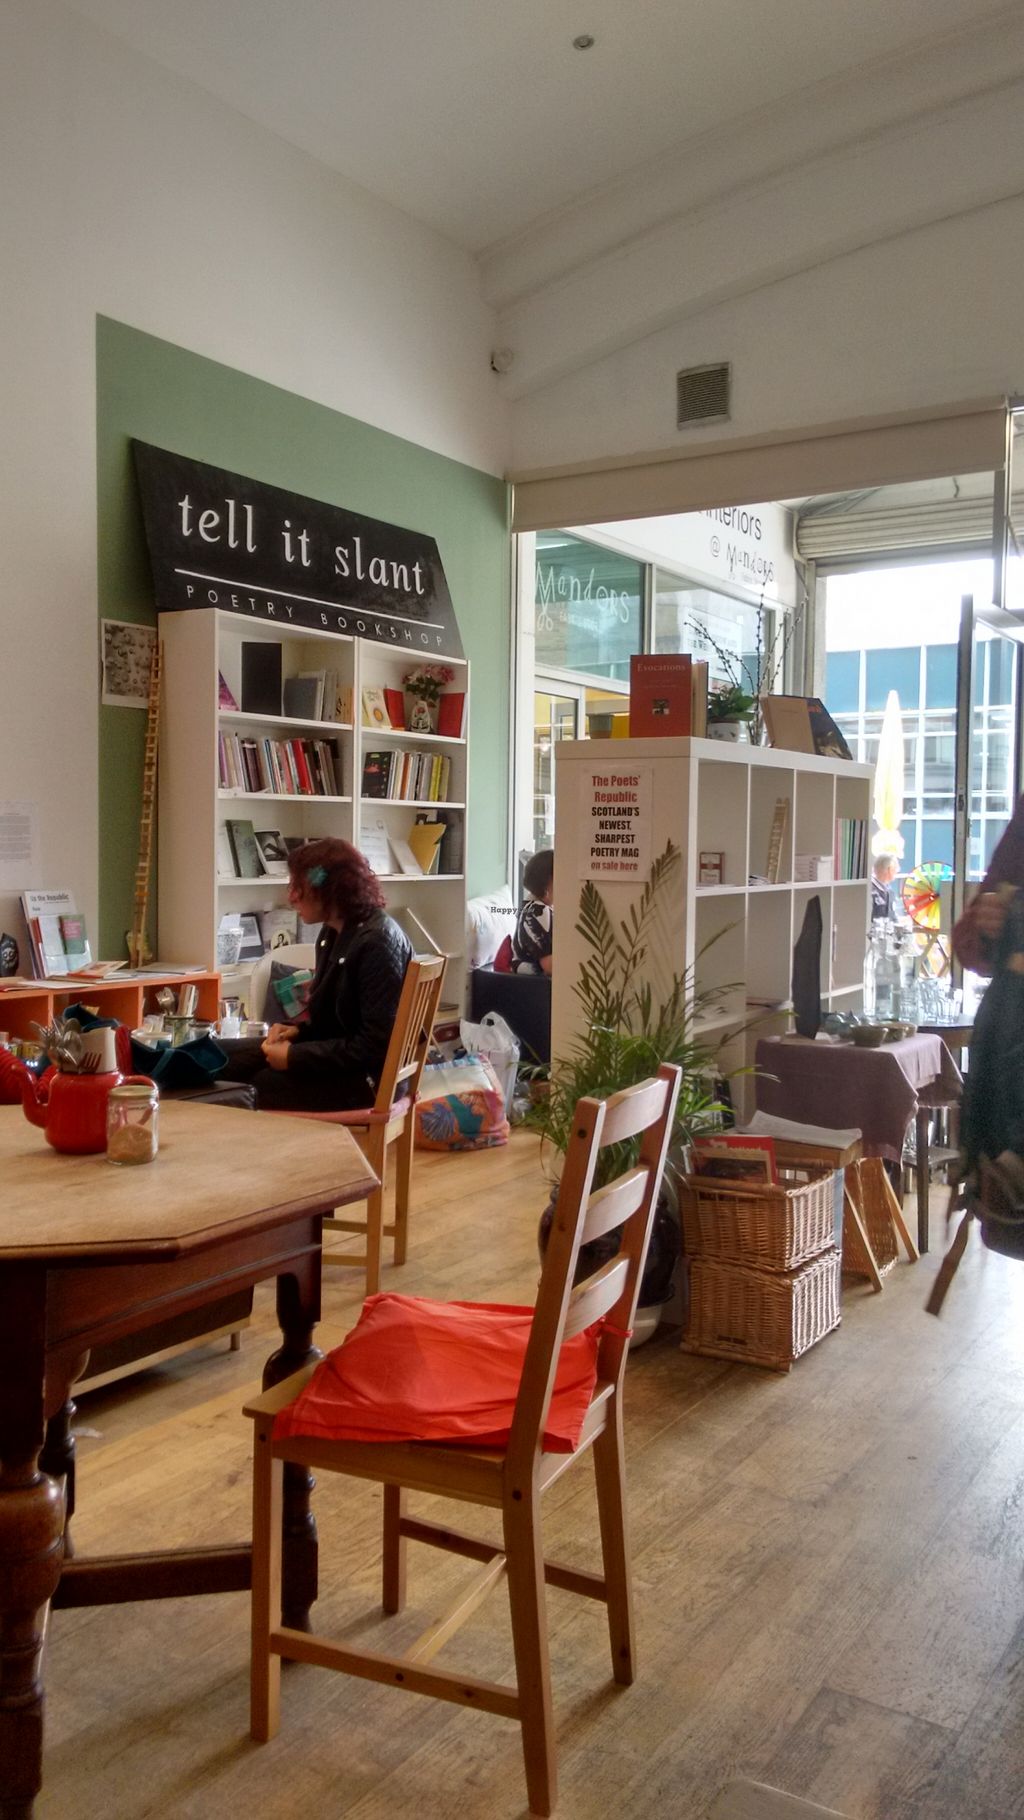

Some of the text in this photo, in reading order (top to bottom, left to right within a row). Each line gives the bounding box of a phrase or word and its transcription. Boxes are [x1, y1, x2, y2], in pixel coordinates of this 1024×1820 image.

[178, 494, 425, 595] tell it slant
[711, 535, 720, 557] @
[186, 584, 443, 647] POETRY BOOKSHOP
[592, 775, 641, 787] The Poets'
[594, 791, 638, 803] Republic
[591, 806, 640, 817] SCOTLAND'S
[594, 833, 636, 844] SHARPEST
[590, 847, 640, 858] POETRY MAG
[590, 861, 638, 871] on sale here
